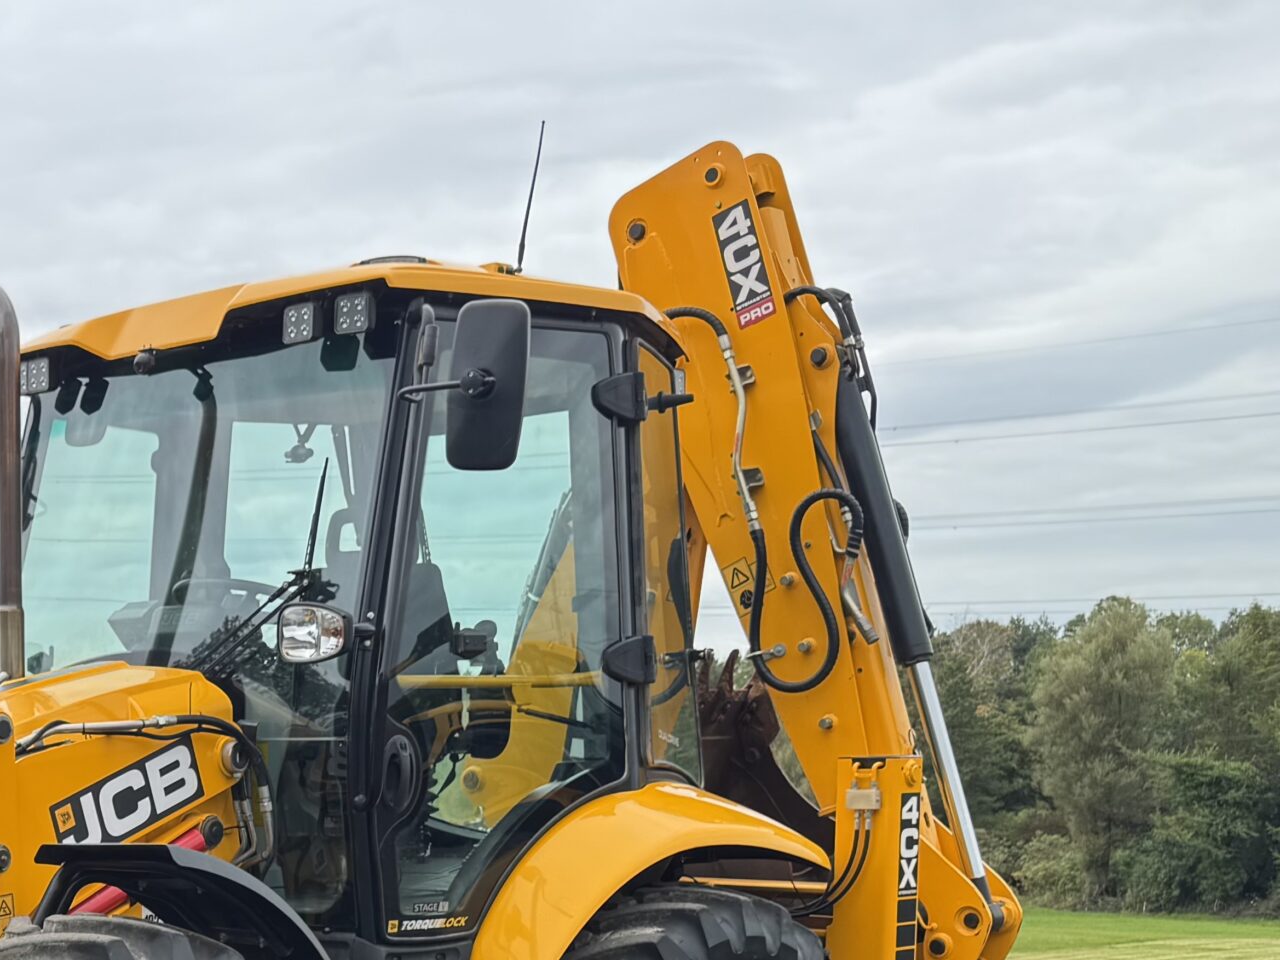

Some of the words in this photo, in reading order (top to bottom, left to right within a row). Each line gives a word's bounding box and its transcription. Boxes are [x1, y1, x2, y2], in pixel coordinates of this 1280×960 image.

[718, 205, 769, 305] 4CX
[739, 302, 774, 327] PRO
[62, 744, 198, 844] JCB
[899, 795, 920, 890] 4CX
[401, 916, 468, 931] TORQUELOCK
[413, 903, 438, 913] STAGE
